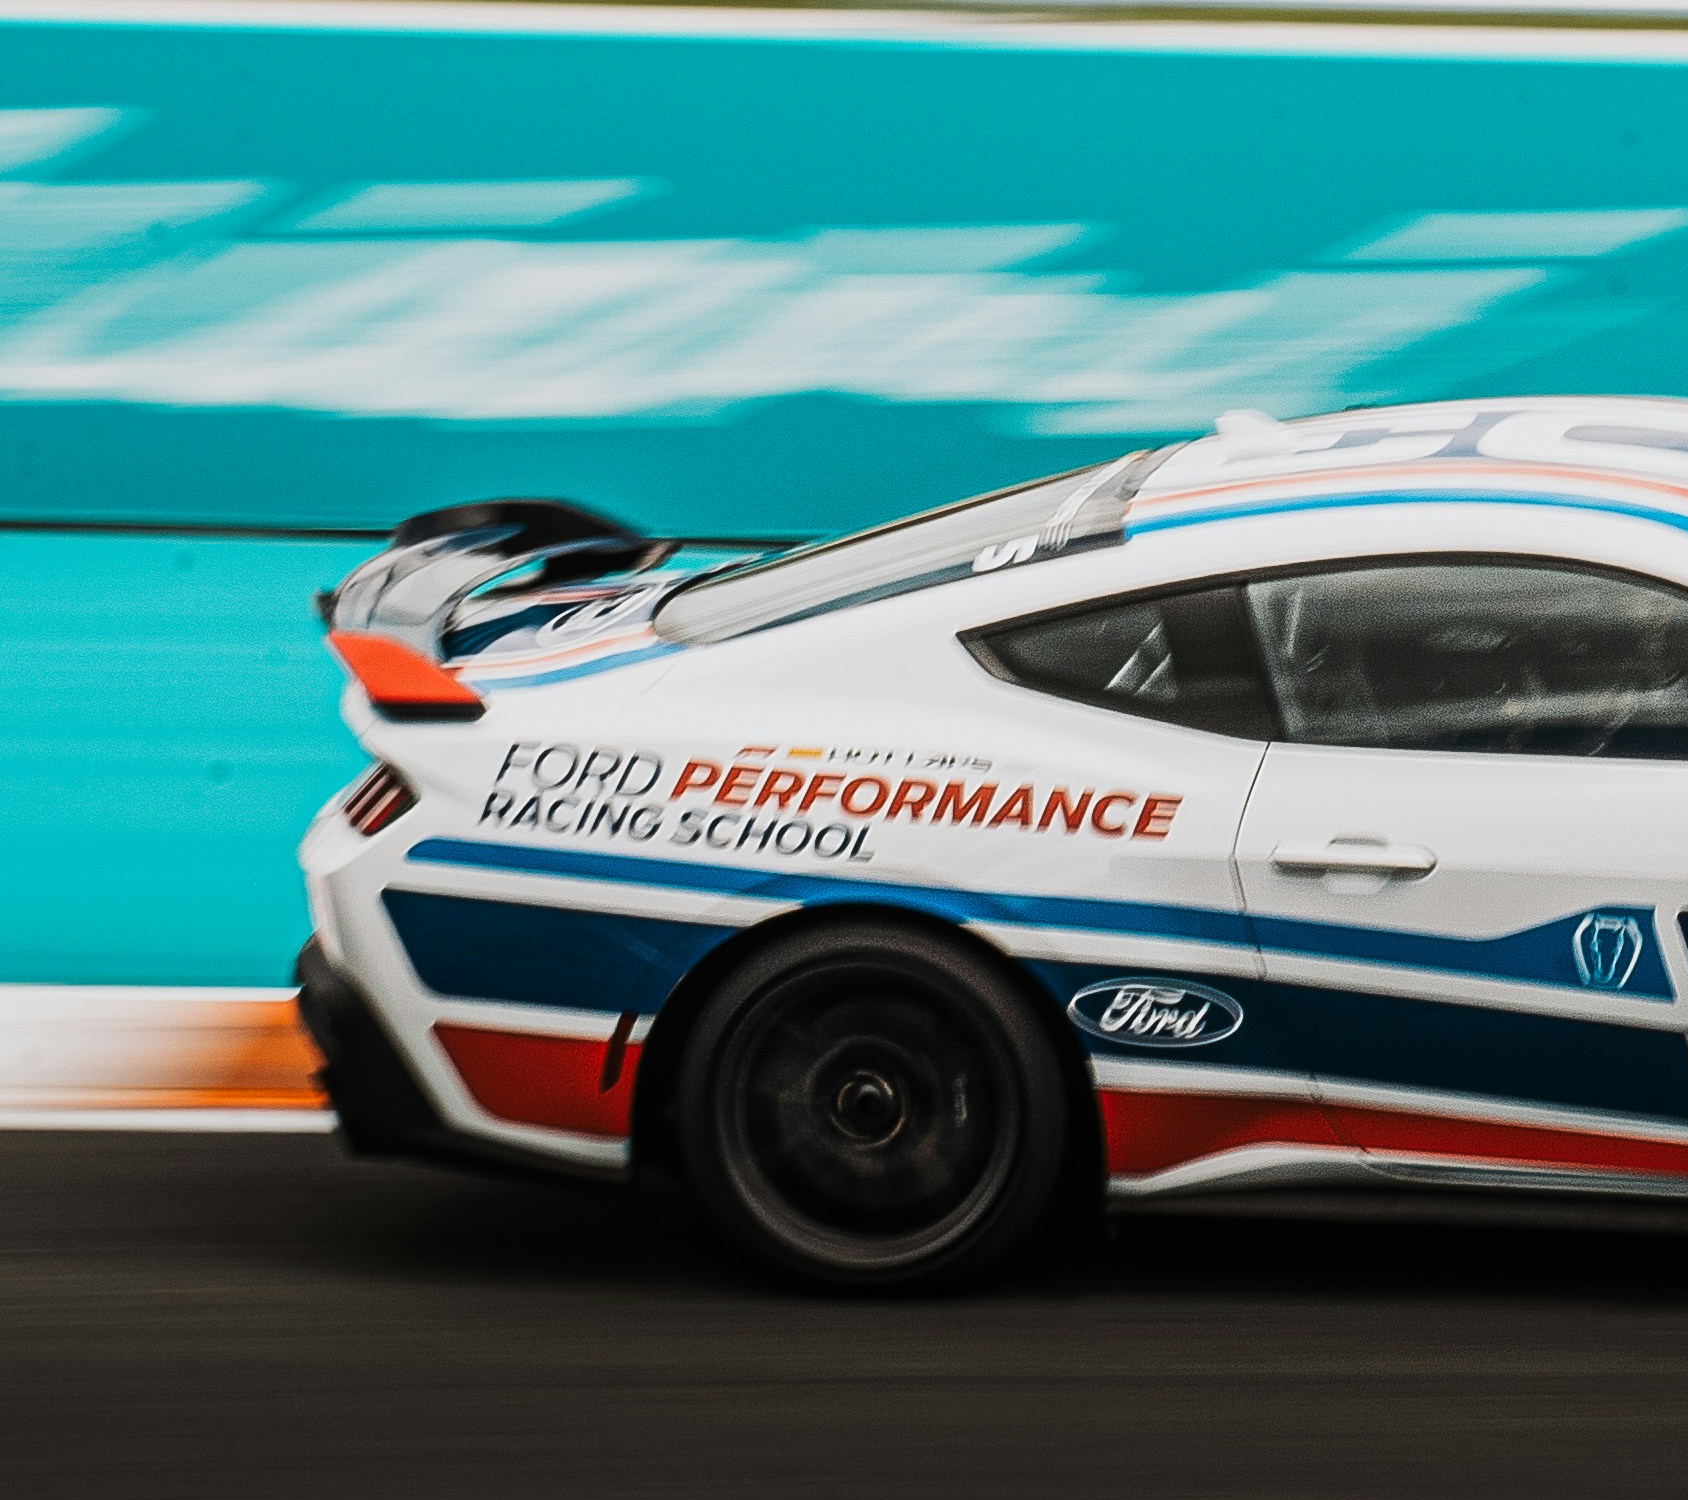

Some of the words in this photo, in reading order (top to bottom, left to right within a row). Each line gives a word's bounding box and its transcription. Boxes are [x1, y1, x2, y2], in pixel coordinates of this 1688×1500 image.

[476, 790, 665, 841] RACING
[667, 808, 876, 863] SCHOOL
[494, 740, 664, 797] FORD
[669, 757, 1184, 841] PERFORMANCE
[1099, 985, 1211, 1039] Ford
